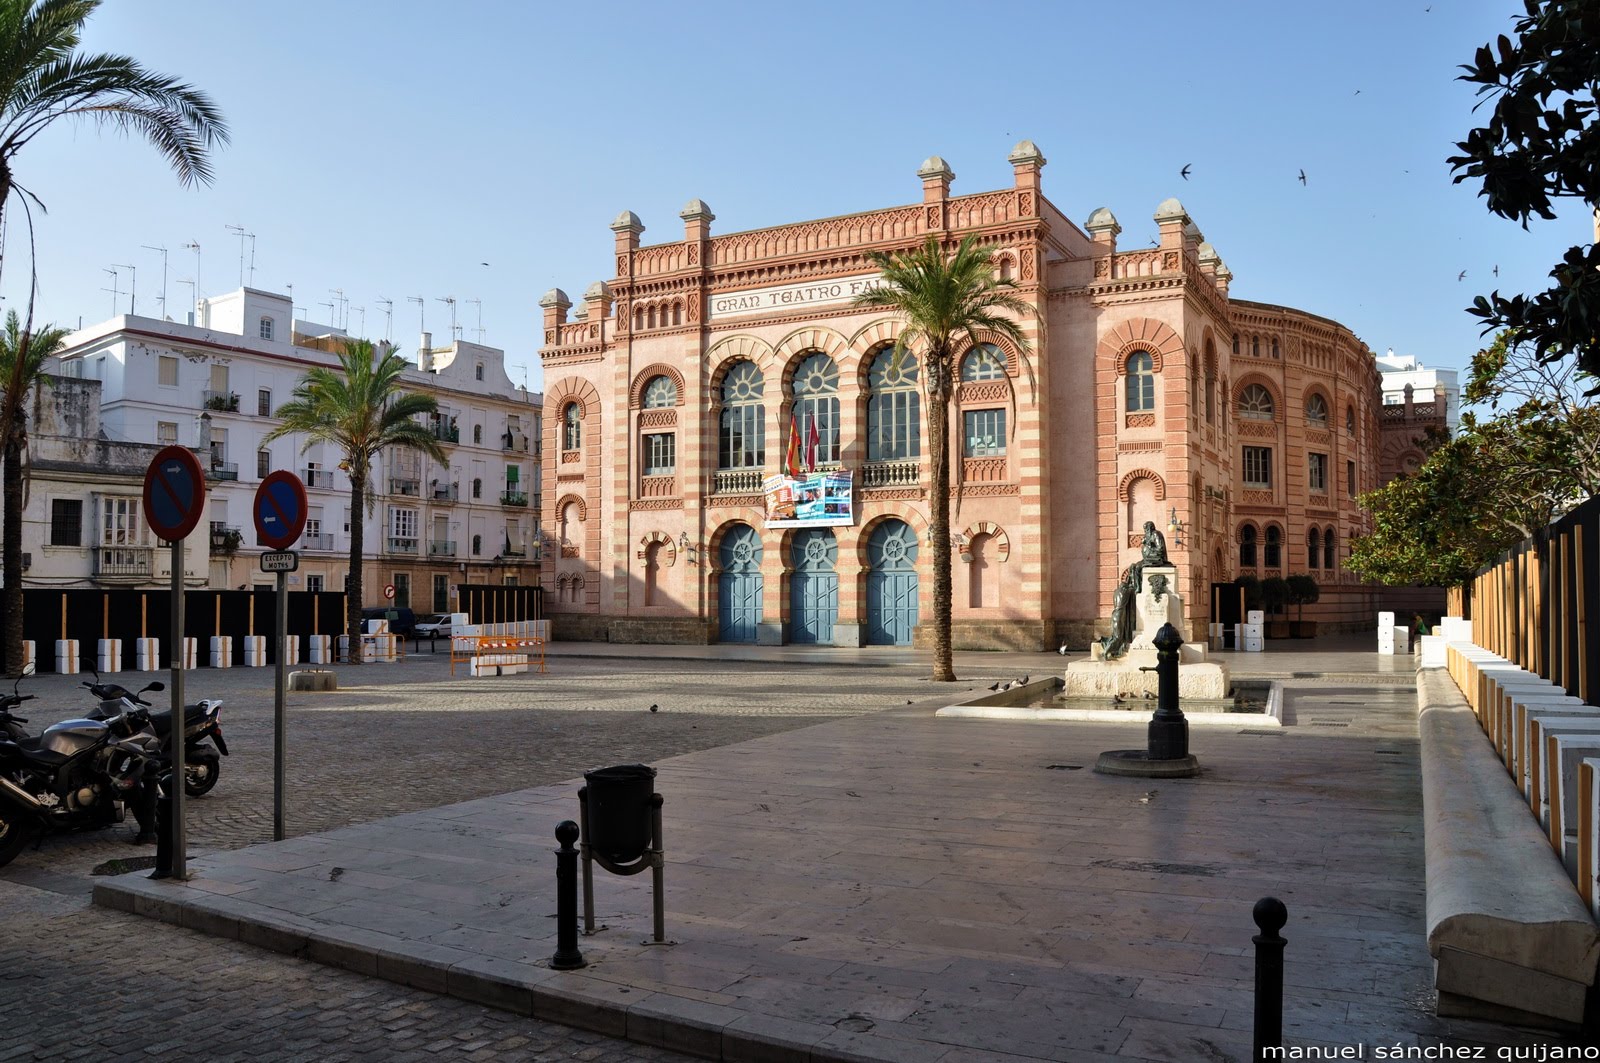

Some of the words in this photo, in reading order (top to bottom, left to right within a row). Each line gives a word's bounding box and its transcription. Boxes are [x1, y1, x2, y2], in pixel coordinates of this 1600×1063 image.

[716, 295, 760, 312] GRAN
[769, 285, 841, 305] TEATRO
[265, 554, 292, 562] EXCEPTO
